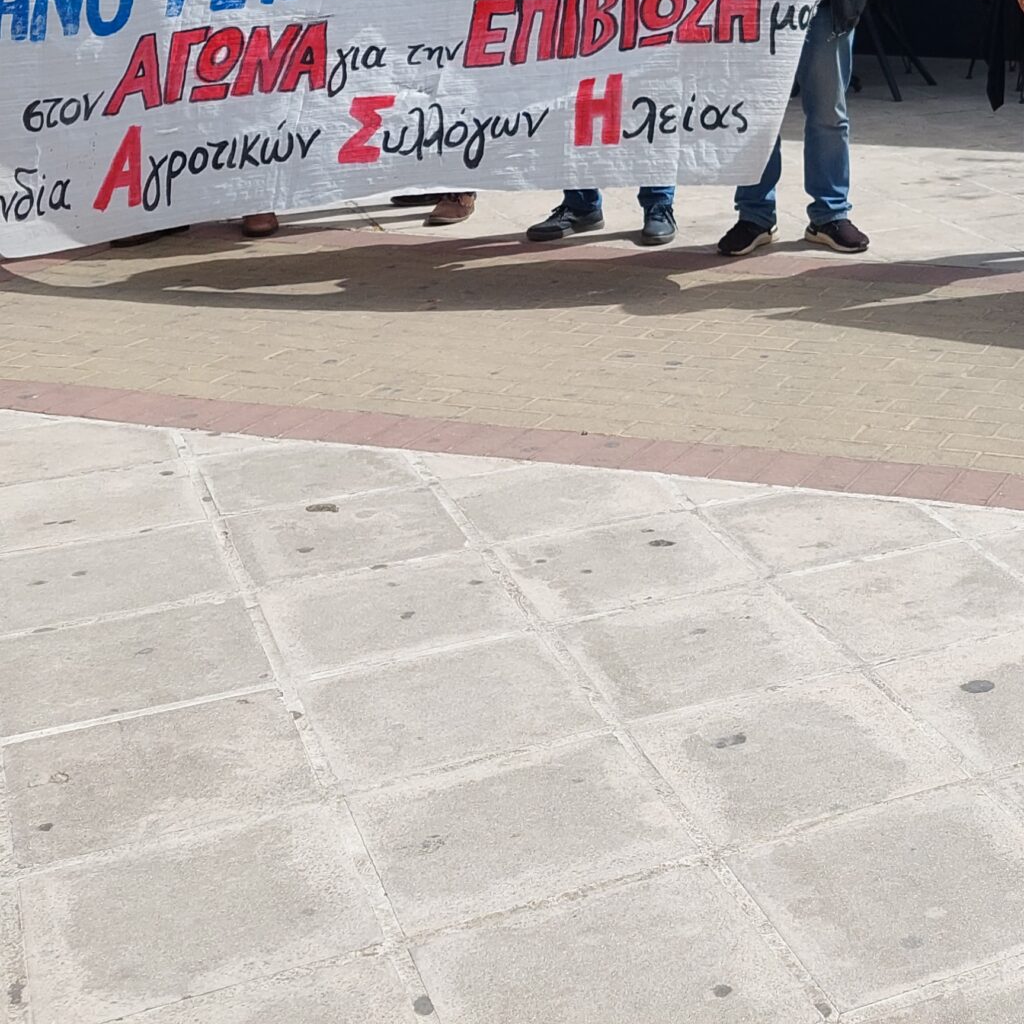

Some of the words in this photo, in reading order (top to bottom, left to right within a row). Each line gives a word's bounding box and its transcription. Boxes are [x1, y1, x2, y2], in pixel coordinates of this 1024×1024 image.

[22, 91, 105, 132] στον
[102, 21, 328, 116] ΑΓΩΝΑ
[327, 45, 385, 98] για
[407, 40, 464, 70] την
[92, 124, 321, 211] Αγροτικών
[336, 94, 549, 169] Συλλόγων
[574, 73, 748, 147] Ηλείας
